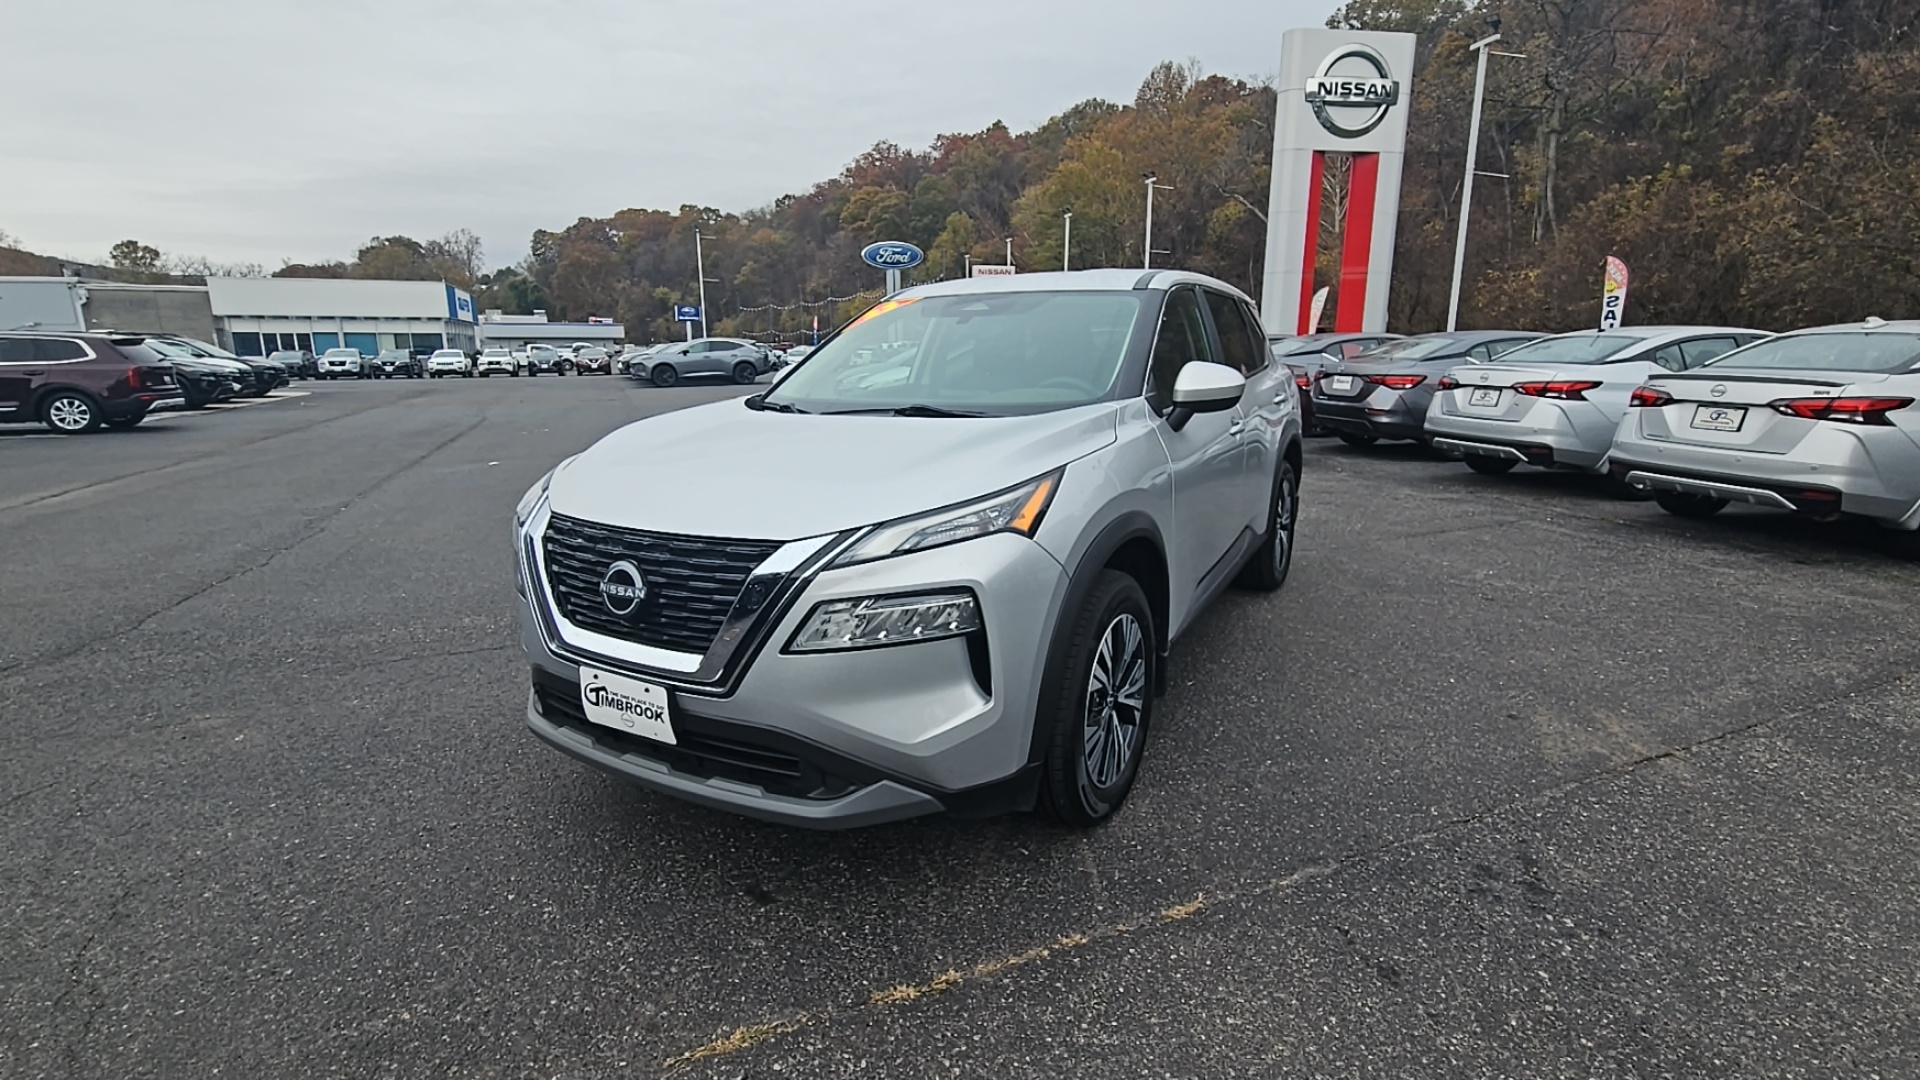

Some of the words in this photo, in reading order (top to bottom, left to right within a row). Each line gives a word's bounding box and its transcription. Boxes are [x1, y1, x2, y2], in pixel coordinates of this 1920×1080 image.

[1317, 82, 1392, 98] NISSAN
[876, 246, 911, 263] Ford
[600, 580, 646, 599] NISSAN
[584, 682, 665, 724] TIMBROOK
